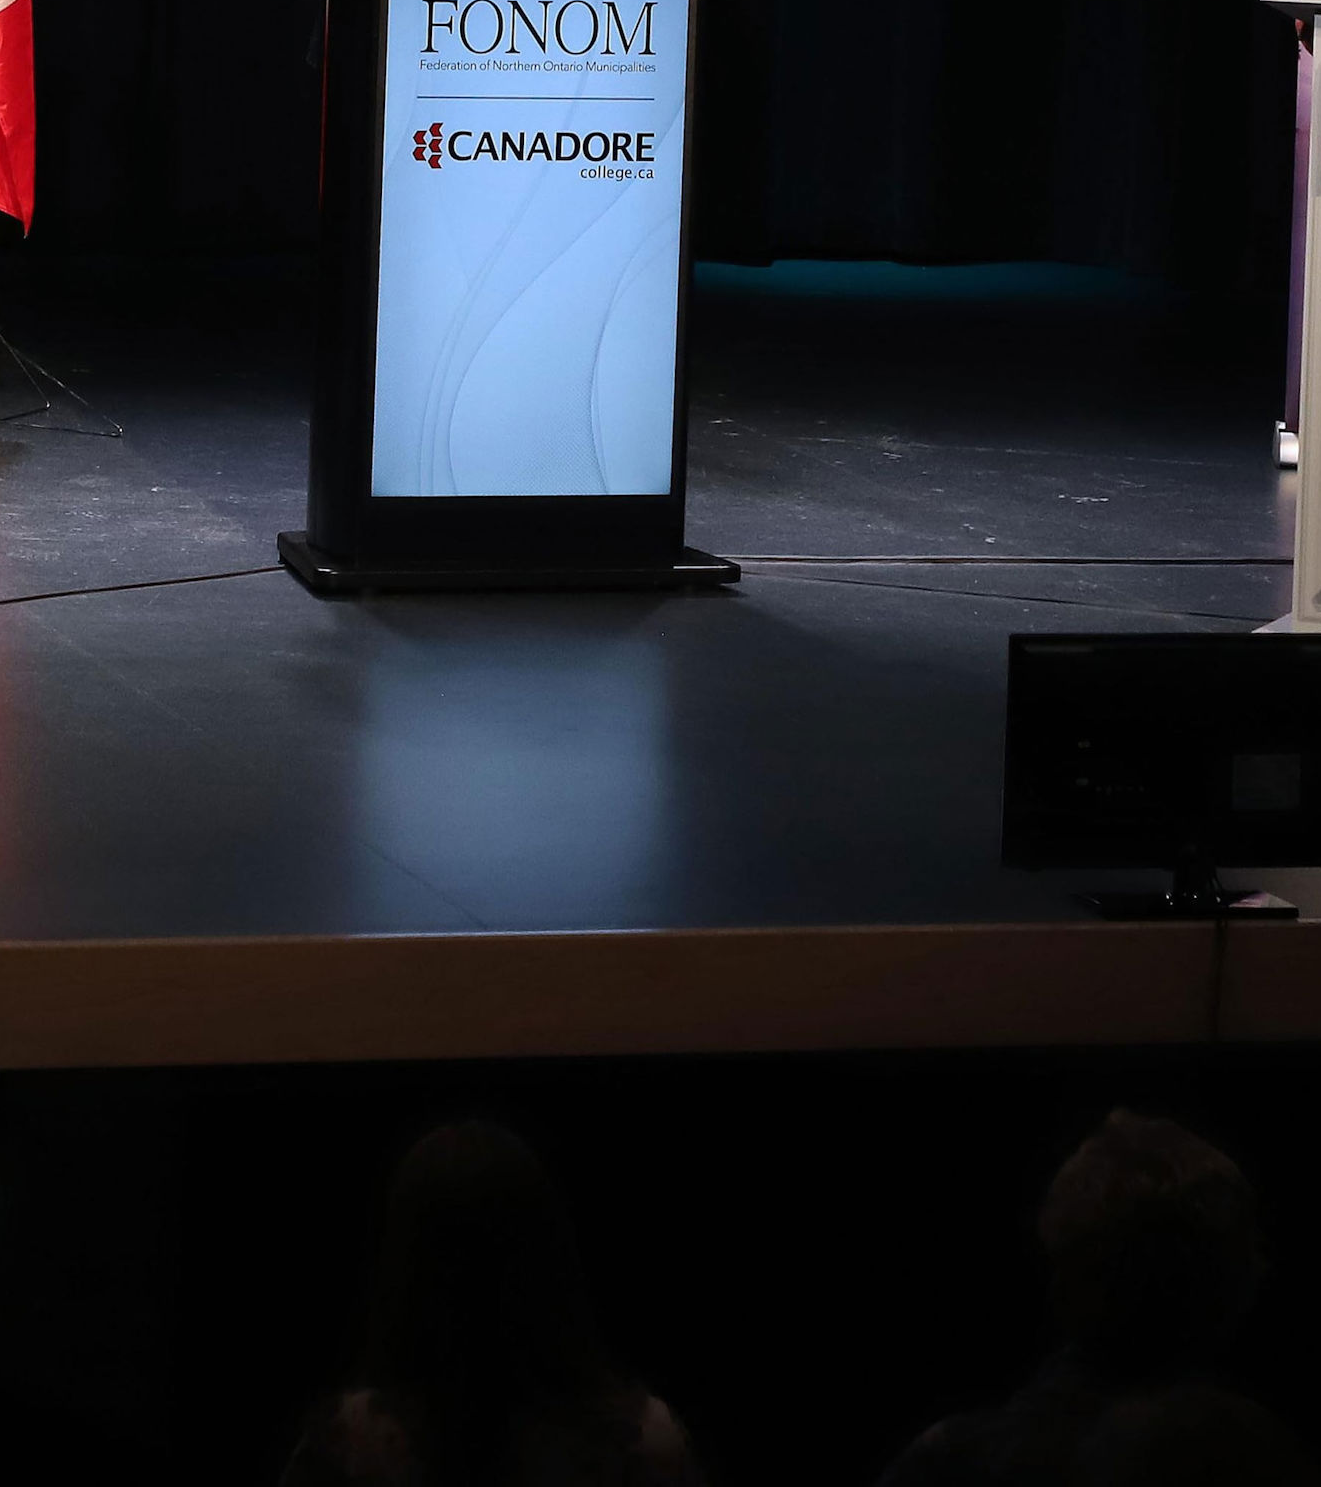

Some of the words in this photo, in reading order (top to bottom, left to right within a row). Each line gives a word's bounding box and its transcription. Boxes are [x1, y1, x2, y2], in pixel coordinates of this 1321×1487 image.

[419, 59, 477, 71] Federation
[479, 59, 491, 71] of
[493, 60, 541, 72] Northern
[543, 61, 584, 73] Ontario
[586, 61, 657, 75] Municipalities
[447, 131, 655, 162] CANADORE
[579, 165, 655, 181] college.ca
